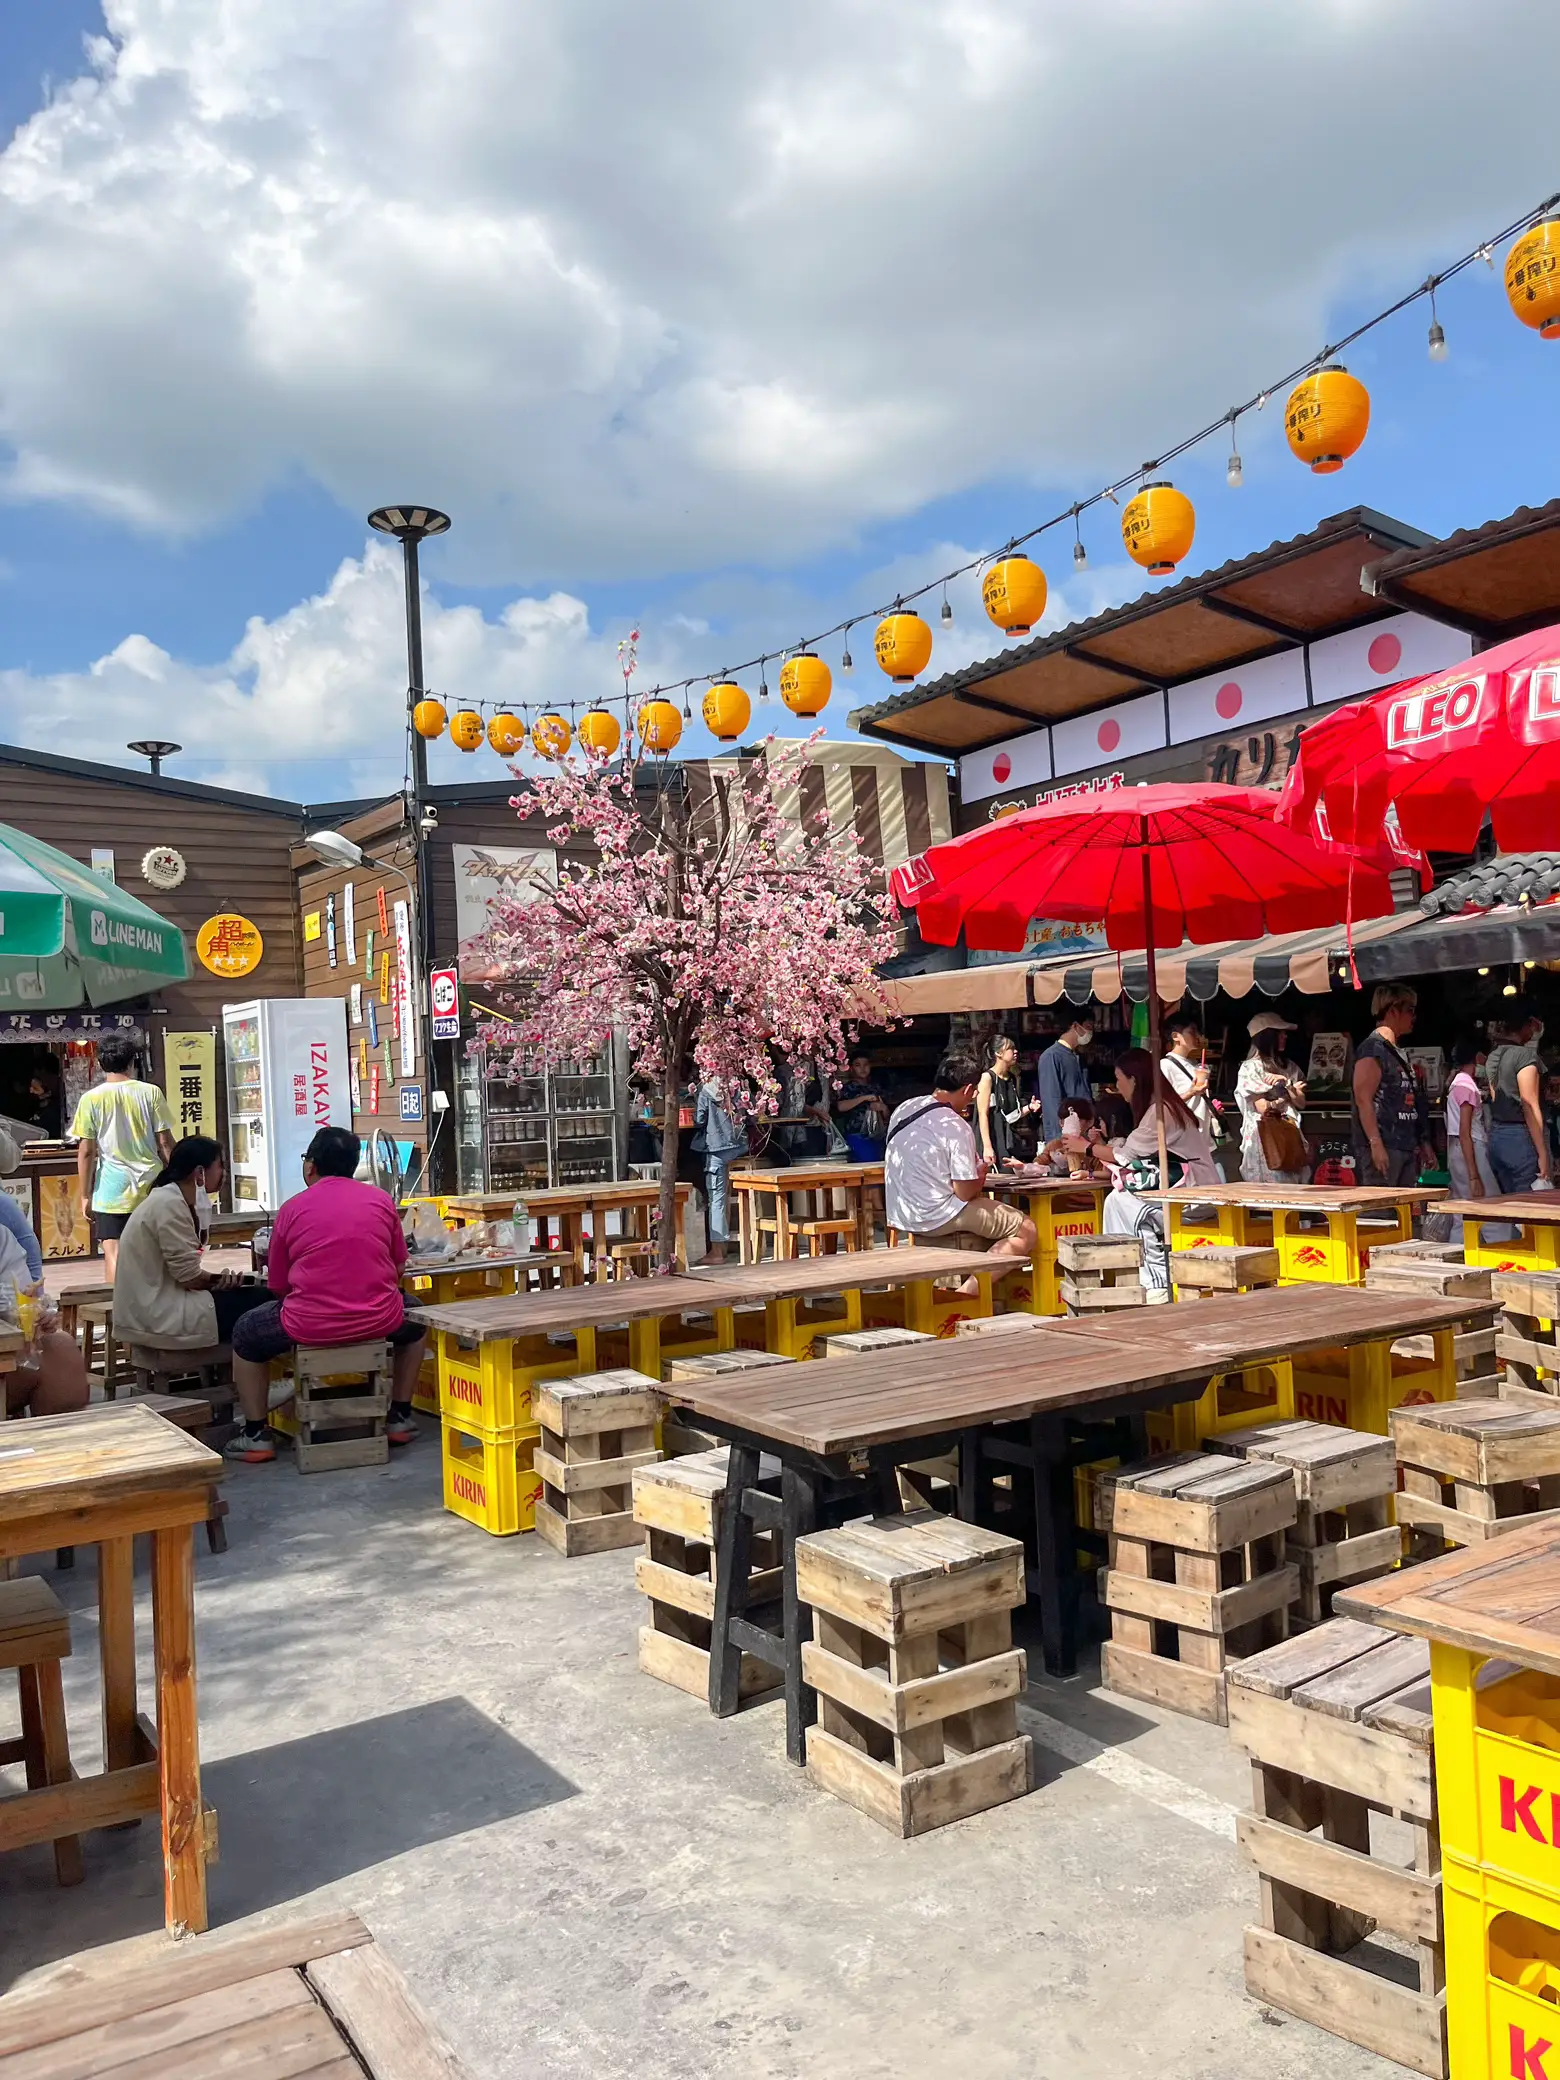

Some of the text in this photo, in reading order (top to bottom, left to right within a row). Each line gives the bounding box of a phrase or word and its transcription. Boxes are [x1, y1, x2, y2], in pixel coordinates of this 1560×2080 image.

[1391, 680, 1482, 746] LEO
[293, 1074, 308, 1117] 居酒屋
[1054, 1222, 1094, 1240] KIRIN
[48, 1243, 86, 1257] スルメ
[449, 1374, 482, 1407] KIRIN
[1297, 1391, 1347, 1425] RIN
[453, 1471, 486, 1508] KIRIN
